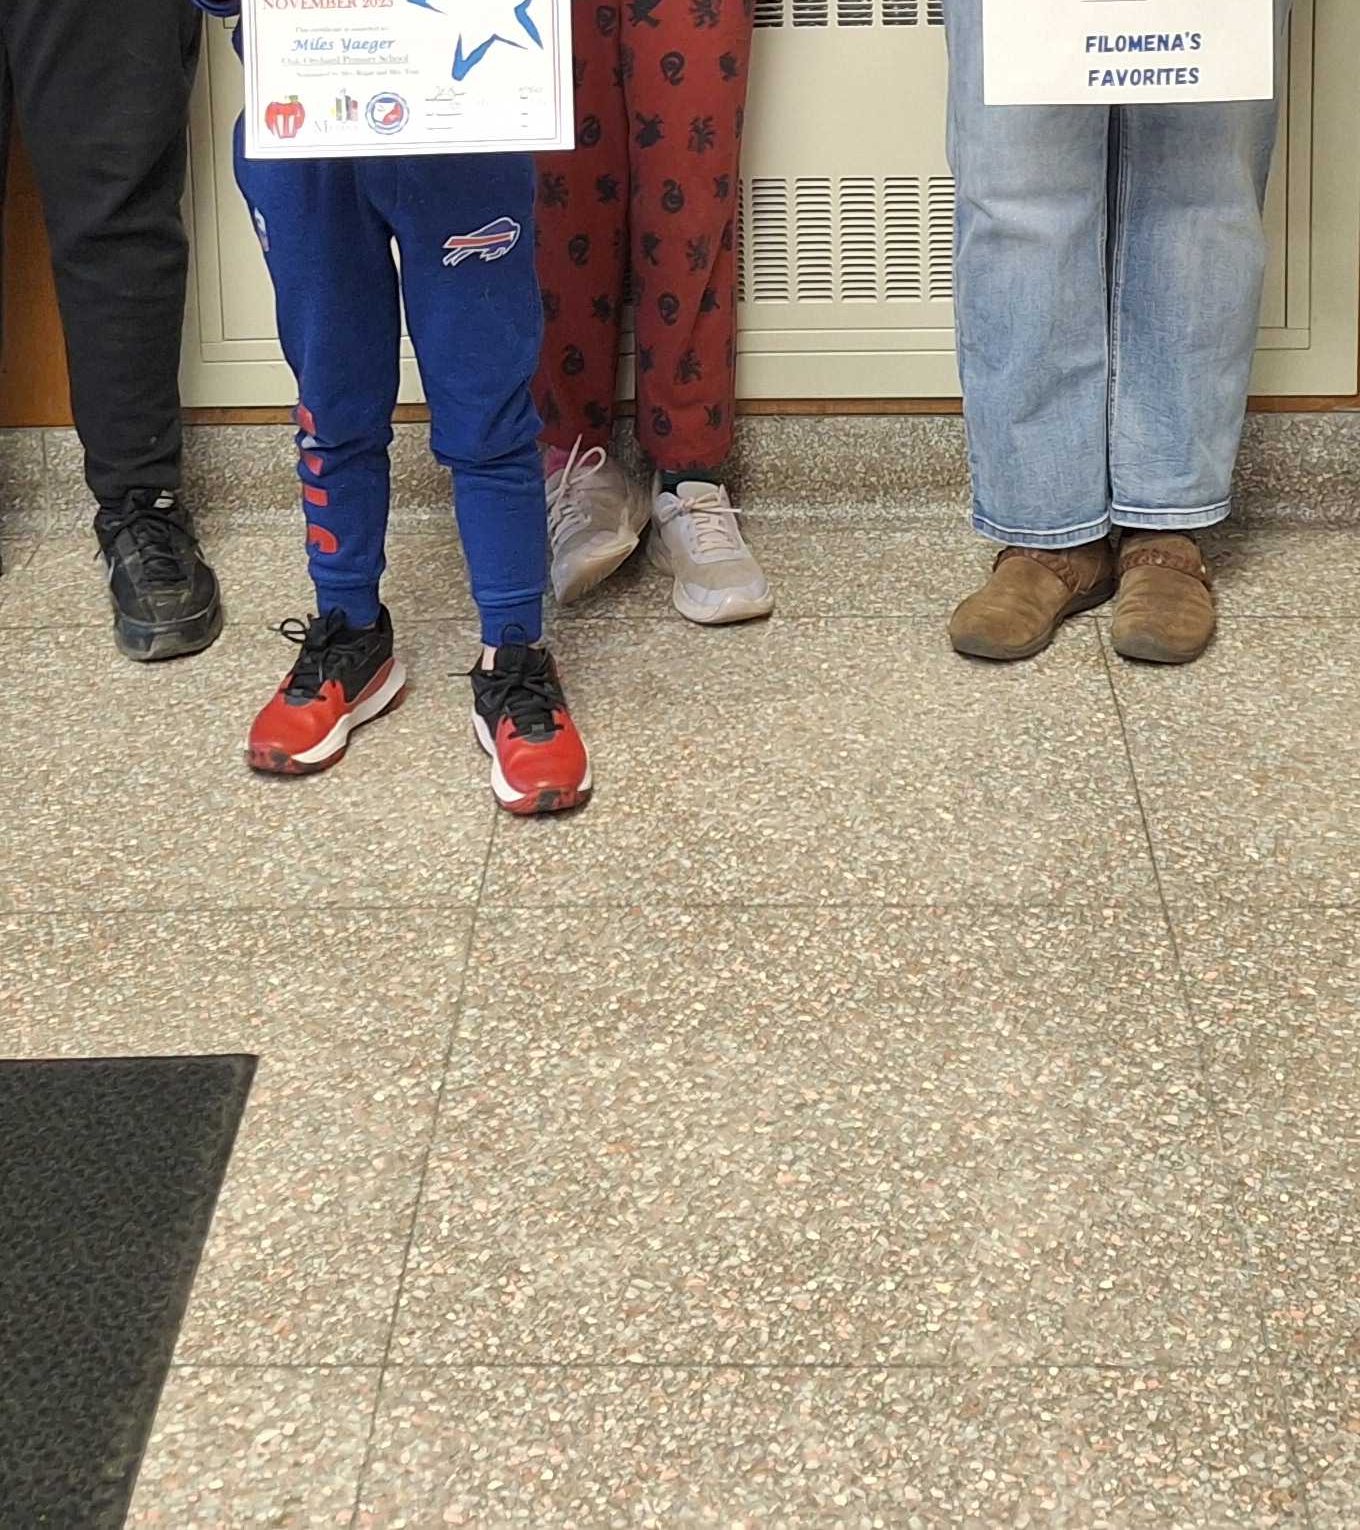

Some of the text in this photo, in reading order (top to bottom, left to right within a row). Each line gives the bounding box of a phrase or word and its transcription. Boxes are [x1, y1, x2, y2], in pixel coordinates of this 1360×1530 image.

[291, 36, 396, 54] Miles Yaeger
[1085, 32, 1202, 54] FILOMENA'S
[1088, 67, 1200, 88] FAVORITES
